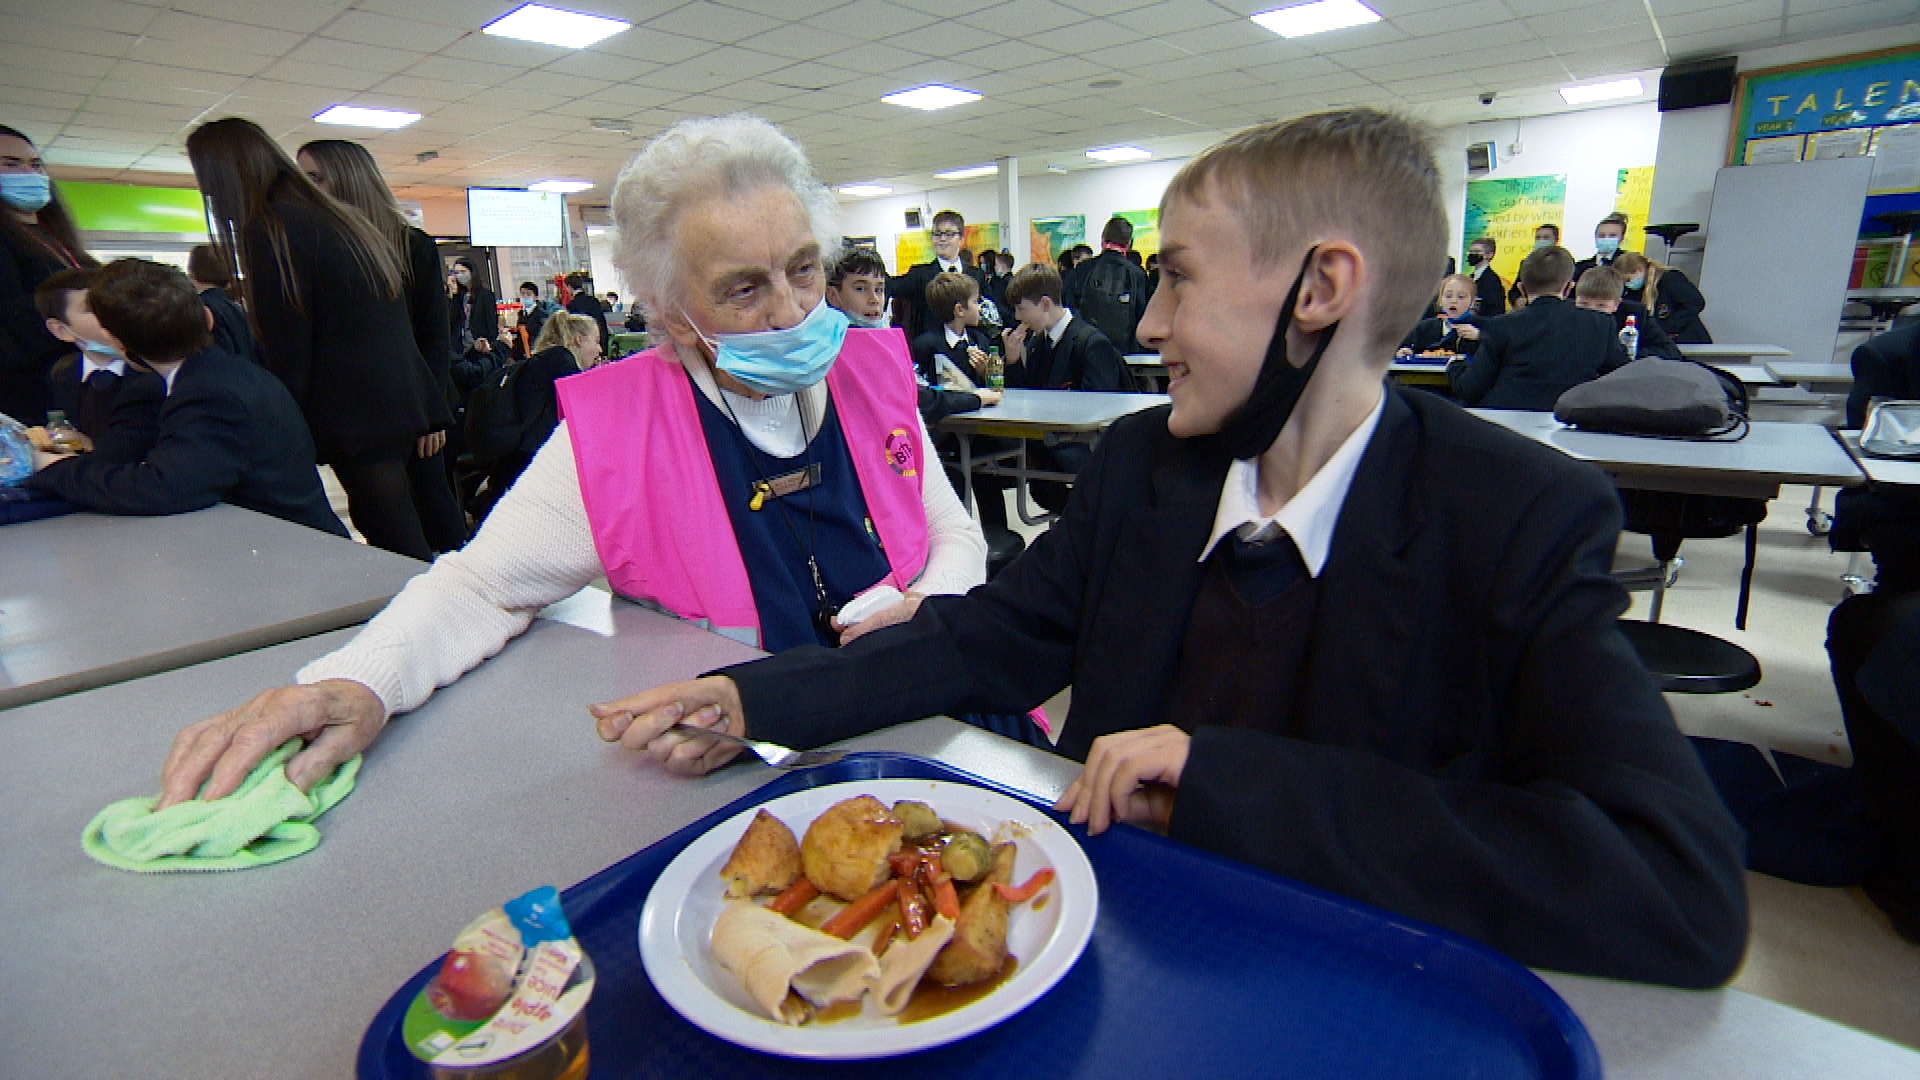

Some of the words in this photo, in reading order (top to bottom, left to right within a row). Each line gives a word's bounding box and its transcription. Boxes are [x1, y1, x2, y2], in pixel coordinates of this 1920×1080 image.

[1767, 80, 1920, 116] TALEN
[1513, 212, 1528, 224] by
[1531, 210, 1562, 222] what
[1490, 226, 1528, 239] others
[527, 975, 558, 1000] uice
